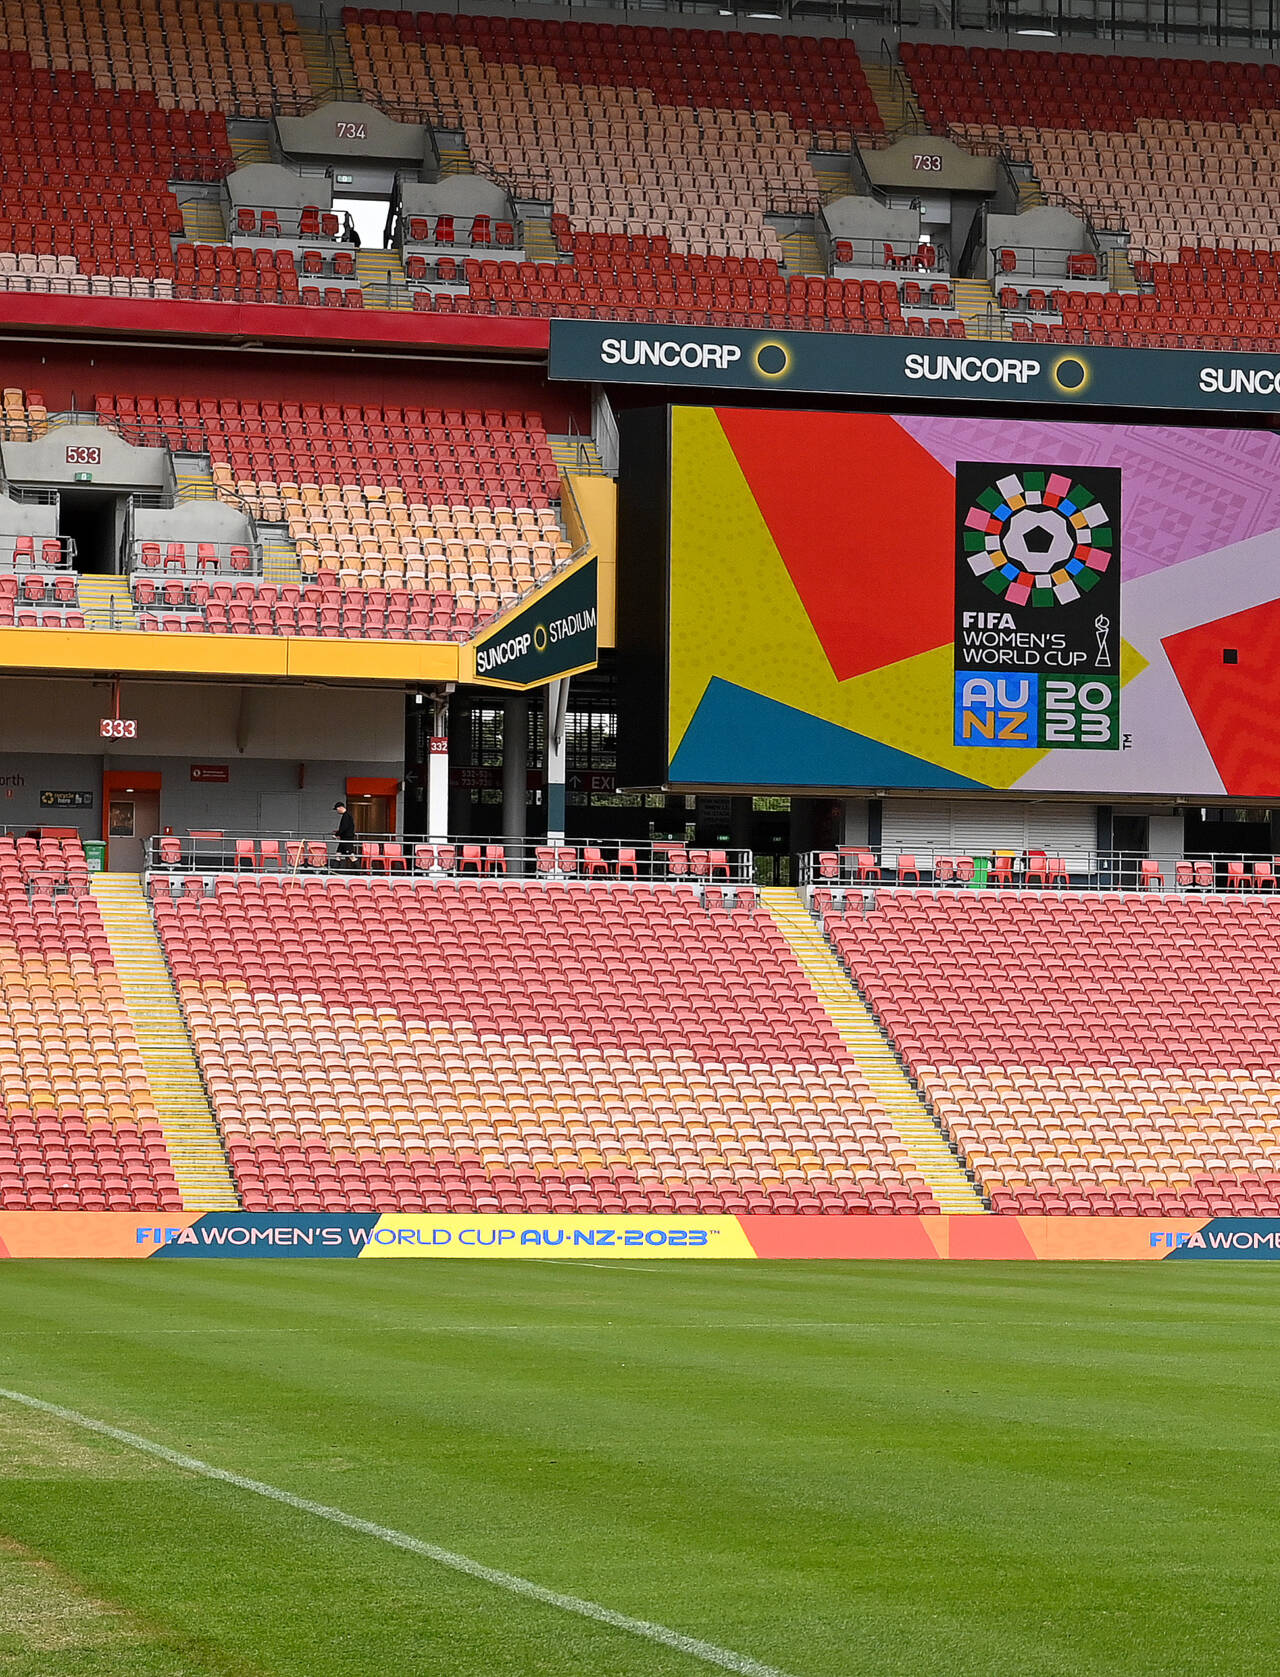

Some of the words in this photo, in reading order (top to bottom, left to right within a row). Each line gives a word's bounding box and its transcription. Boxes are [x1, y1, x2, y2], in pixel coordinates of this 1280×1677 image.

[337, 122, 366, 139] 734
[913, 155, 941, 171] 733
[600, 338, 742, 369] SUNCORP
[904, 354, 1041, 385] SUNCORP
[67, 447, 99, 463] 533
[962, 611, 1016, 630] FIFA
[477, 633, 531, 673] SUNCORP
[549, 607, 597, 643] STADIUM
[963, 631, 1066, 649] WOMEN'S
[963, 648, 1040, 665] WORLD
[1044, 651, 1088, 666] CUP
[962, 678, 1029, 709] AU
[1045, 681, 1112, 711] 20
[102, 719, 136, 738] 333
[962, 710, 1028, 740] NZ
[1045, 712, 1111, 743] 23
[430, 742, 448, 752] 332
[592, 776, 615, 790] EXI
[136, 1227, 199, 1244] FIFA
[200, 1228, 342, 1245] WOMEN'S
[351, 1228, 451, 1245] WORLD
[458, 1229, 515, 1246] CUP
[1150, 1232, 1206, 1249] FIFA
